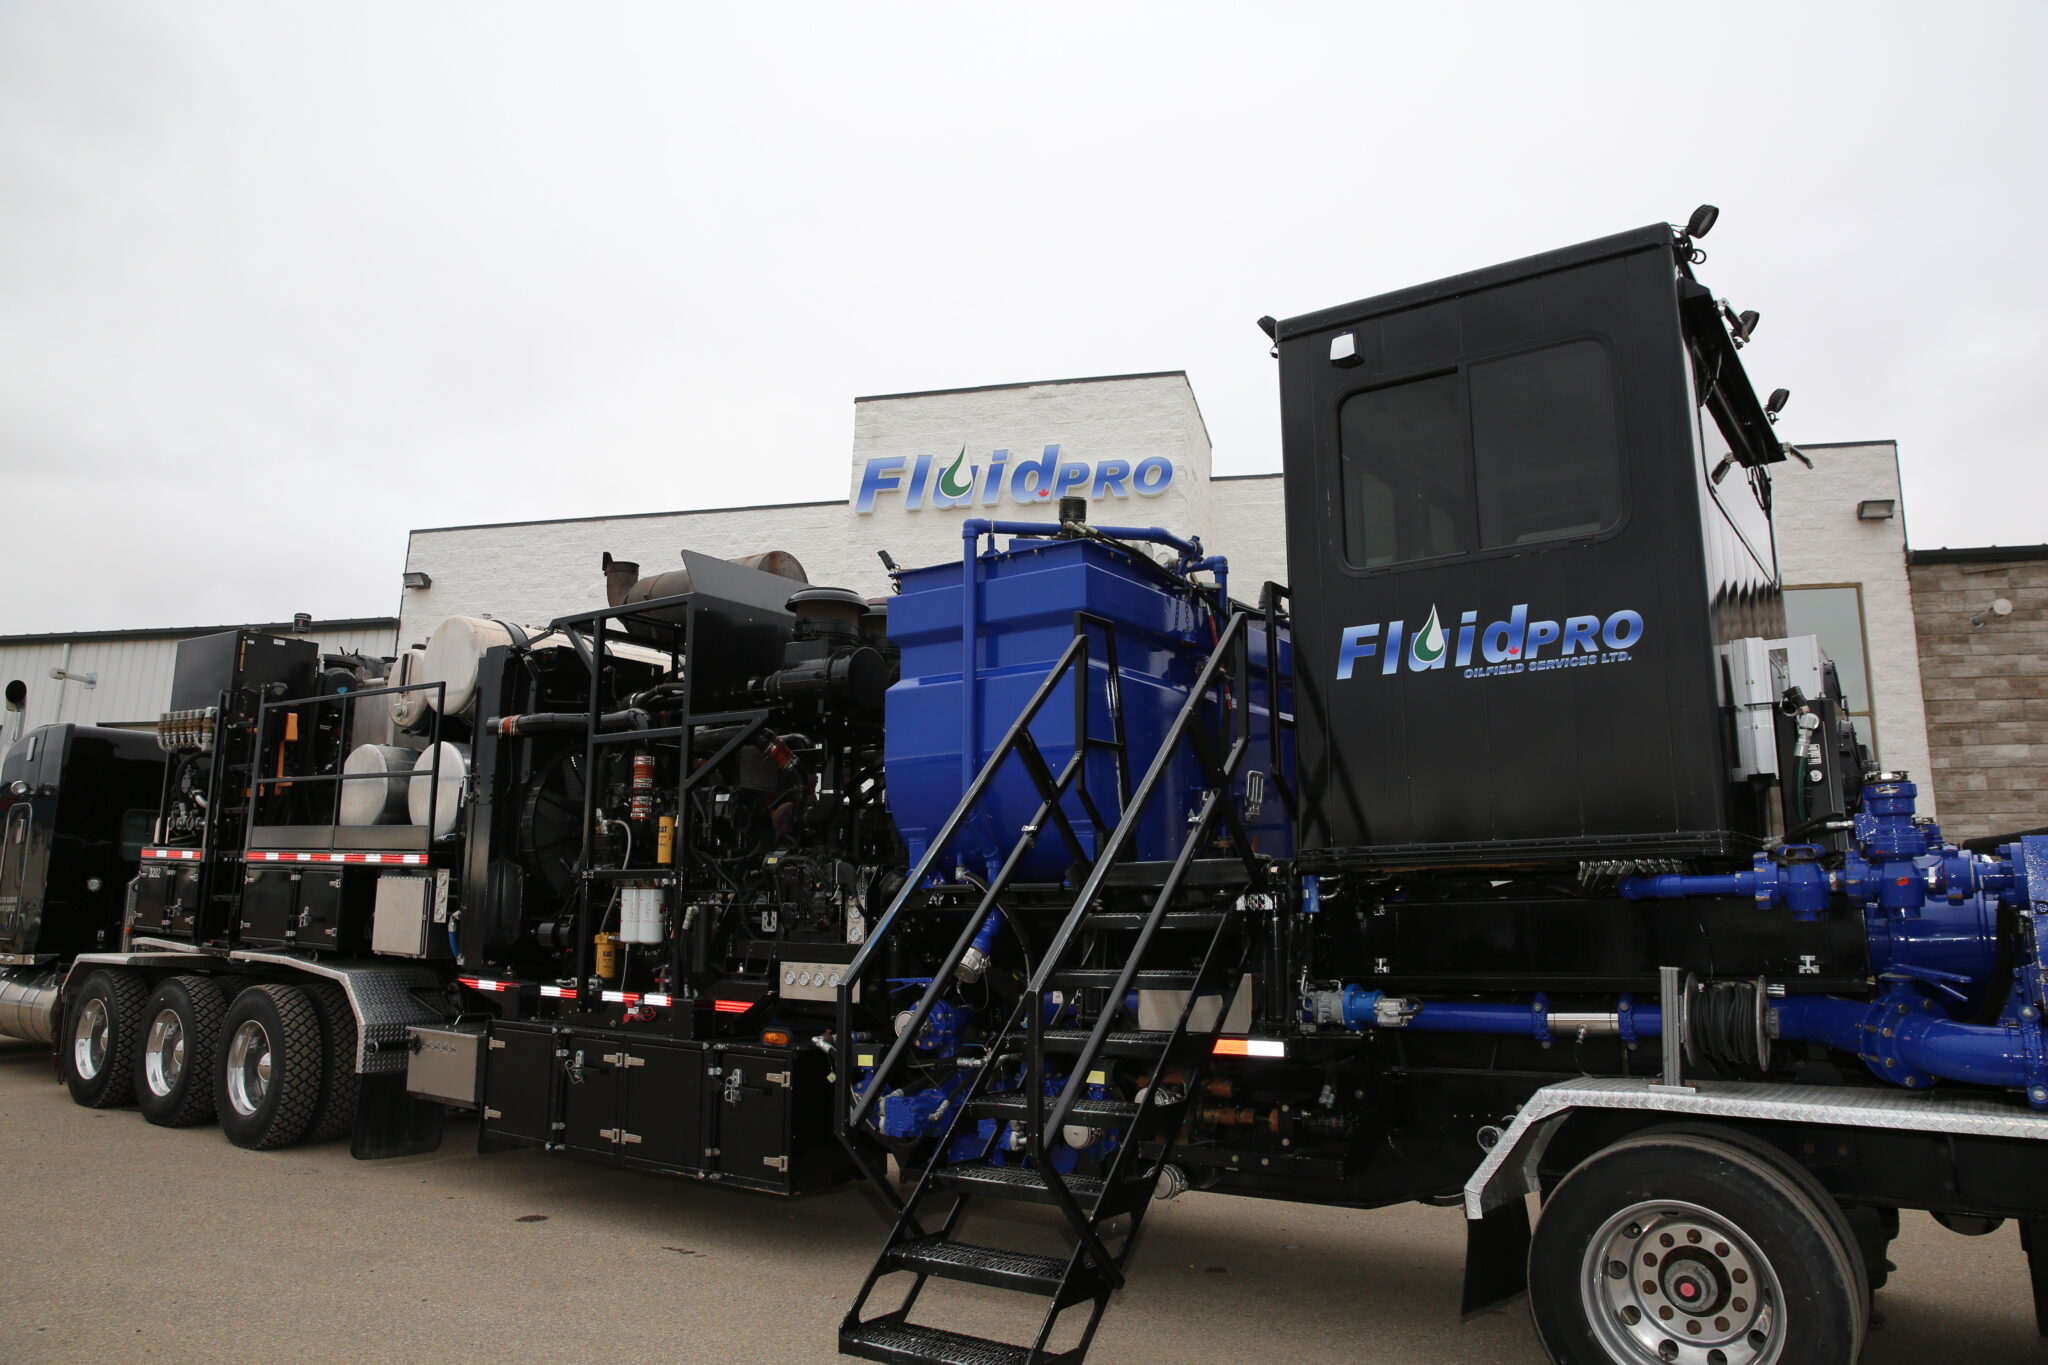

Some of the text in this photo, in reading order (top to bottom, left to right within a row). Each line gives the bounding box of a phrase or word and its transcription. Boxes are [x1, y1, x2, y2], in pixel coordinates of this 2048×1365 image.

[1463, 651, 1633, 679] OILFIELD SERVICES LTD.
